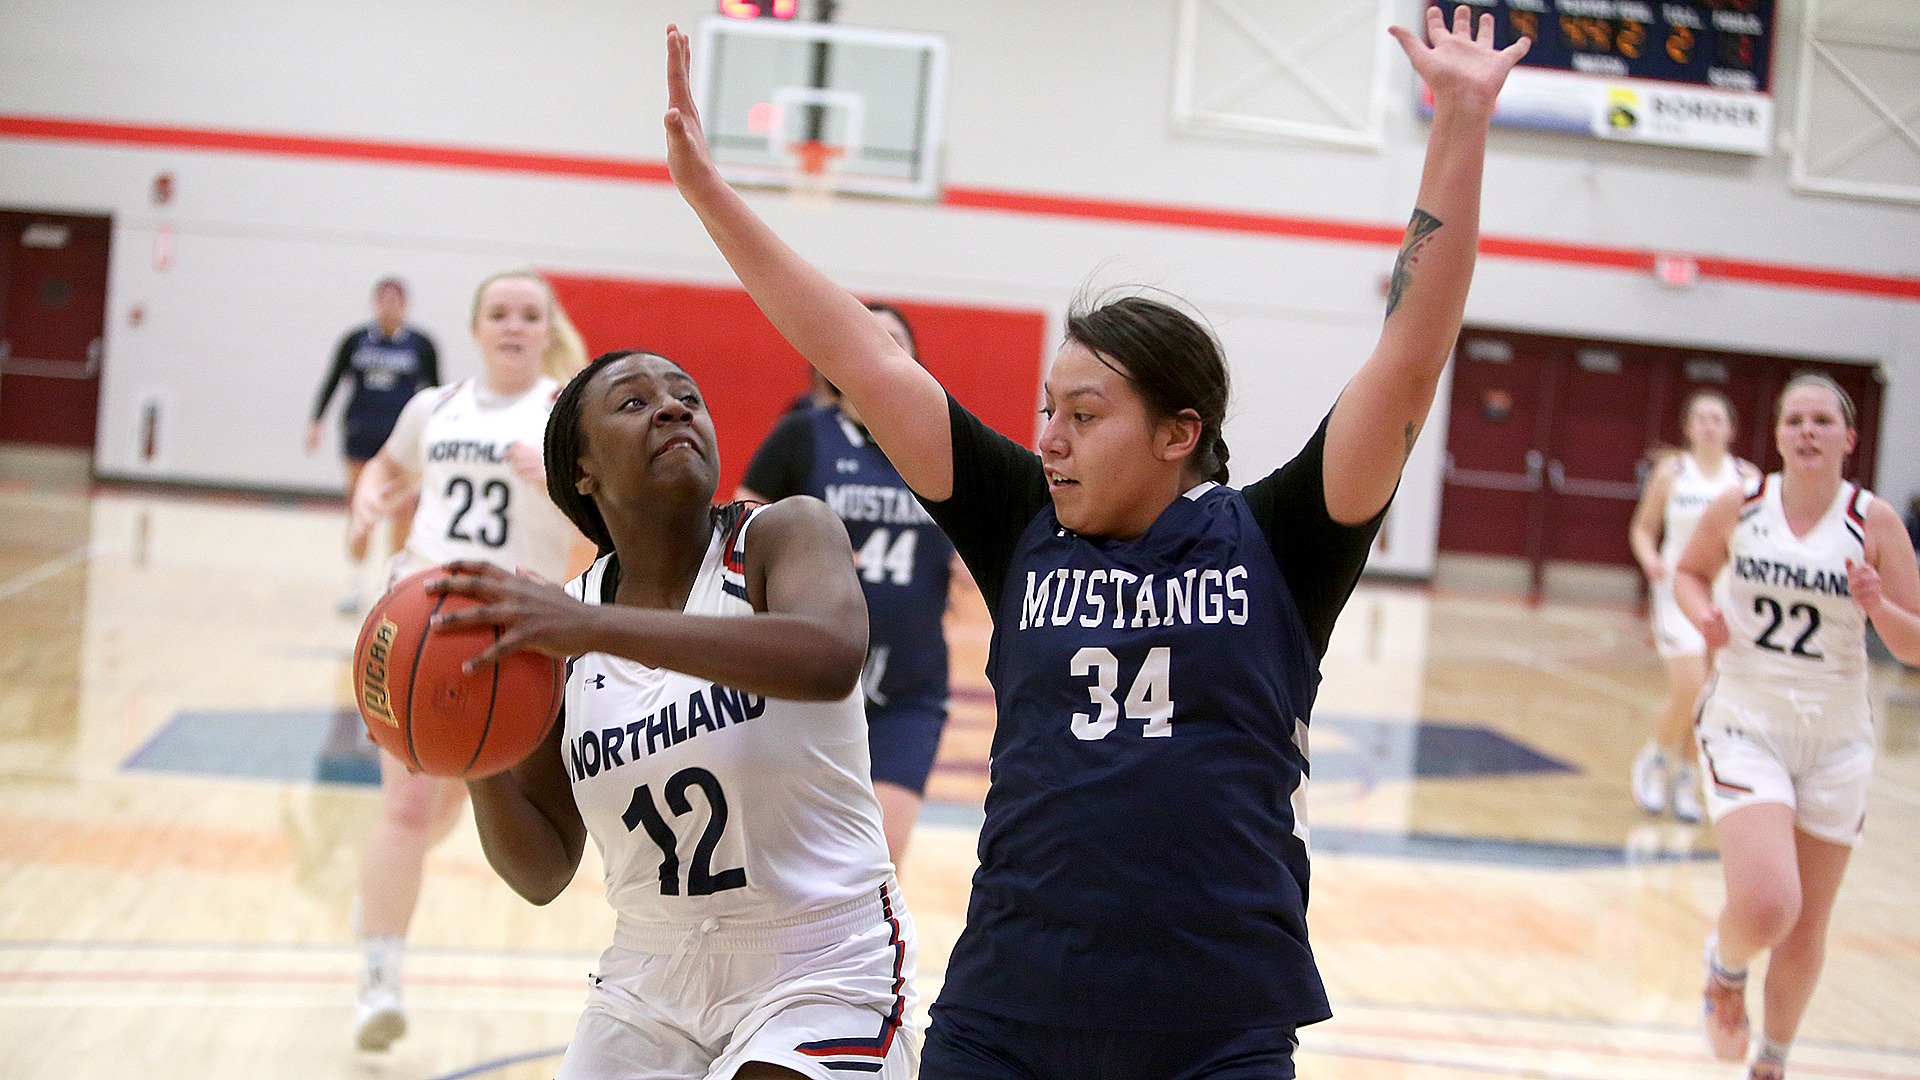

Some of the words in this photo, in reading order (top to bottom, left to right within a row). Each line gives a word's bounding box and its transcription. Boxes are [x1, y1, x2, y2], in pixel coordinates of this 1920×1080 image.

[445, 475, 510, 548] 23
[858, 527, 919, 584] 44
[1019, 565, 1249, 631] MUSTANGS
[1754, 595, 1825, 661] 22
[1070, 647, 1174, 740] 34
[570, 683, 766, 783] NORTHLAND
[621, 767, 747, 896] 12
